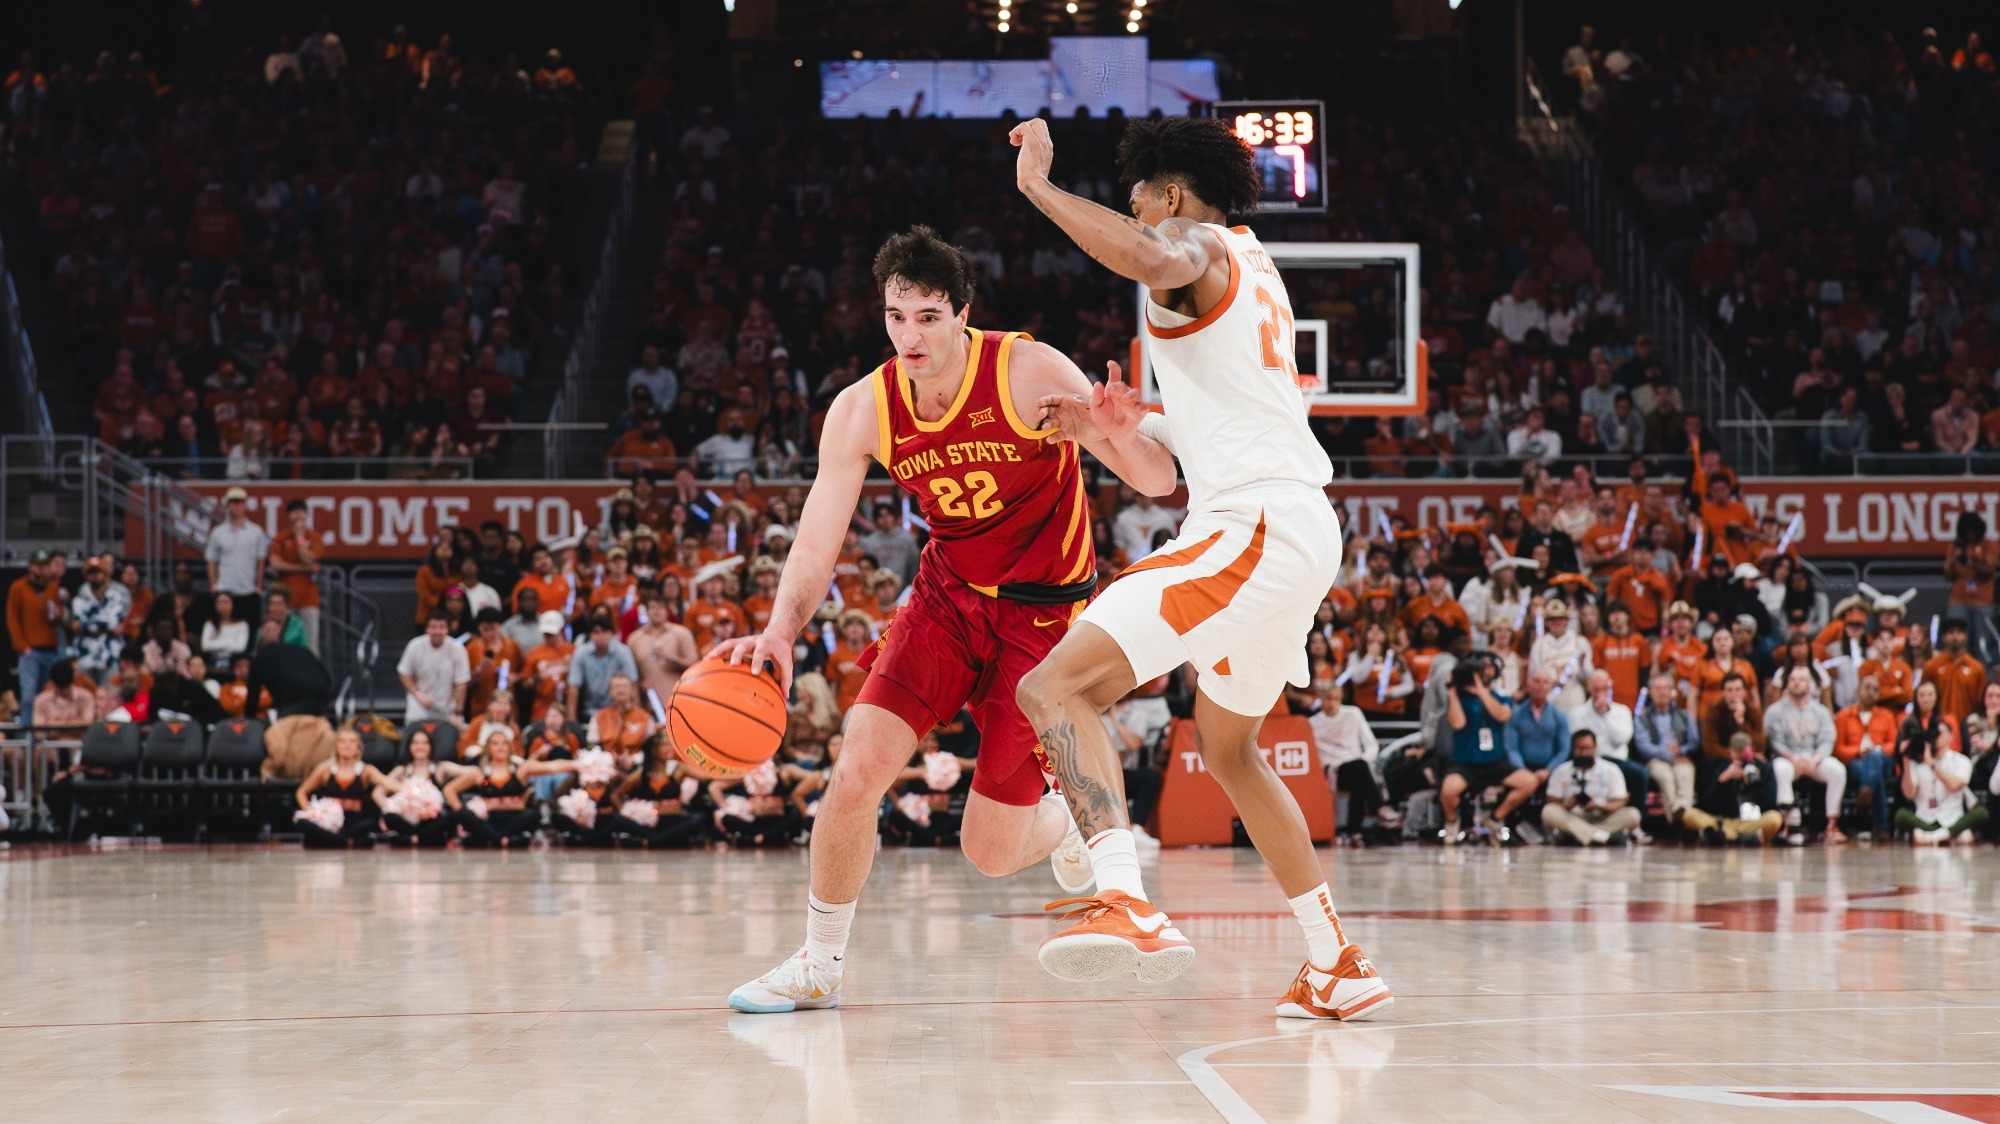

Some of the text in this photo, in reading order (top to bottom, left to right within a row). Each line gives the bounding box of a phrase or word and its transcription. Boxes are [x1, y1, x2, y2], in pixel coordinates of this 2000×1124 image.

[1235, 111, 1314, 145] 16:33
[1274, 145, 1306, 198] 7
[892, 440, 1022, 481] IOWA STATE
[929, 470, 1005, 519] 22
[168, 496, 470, 545] WLCOME
